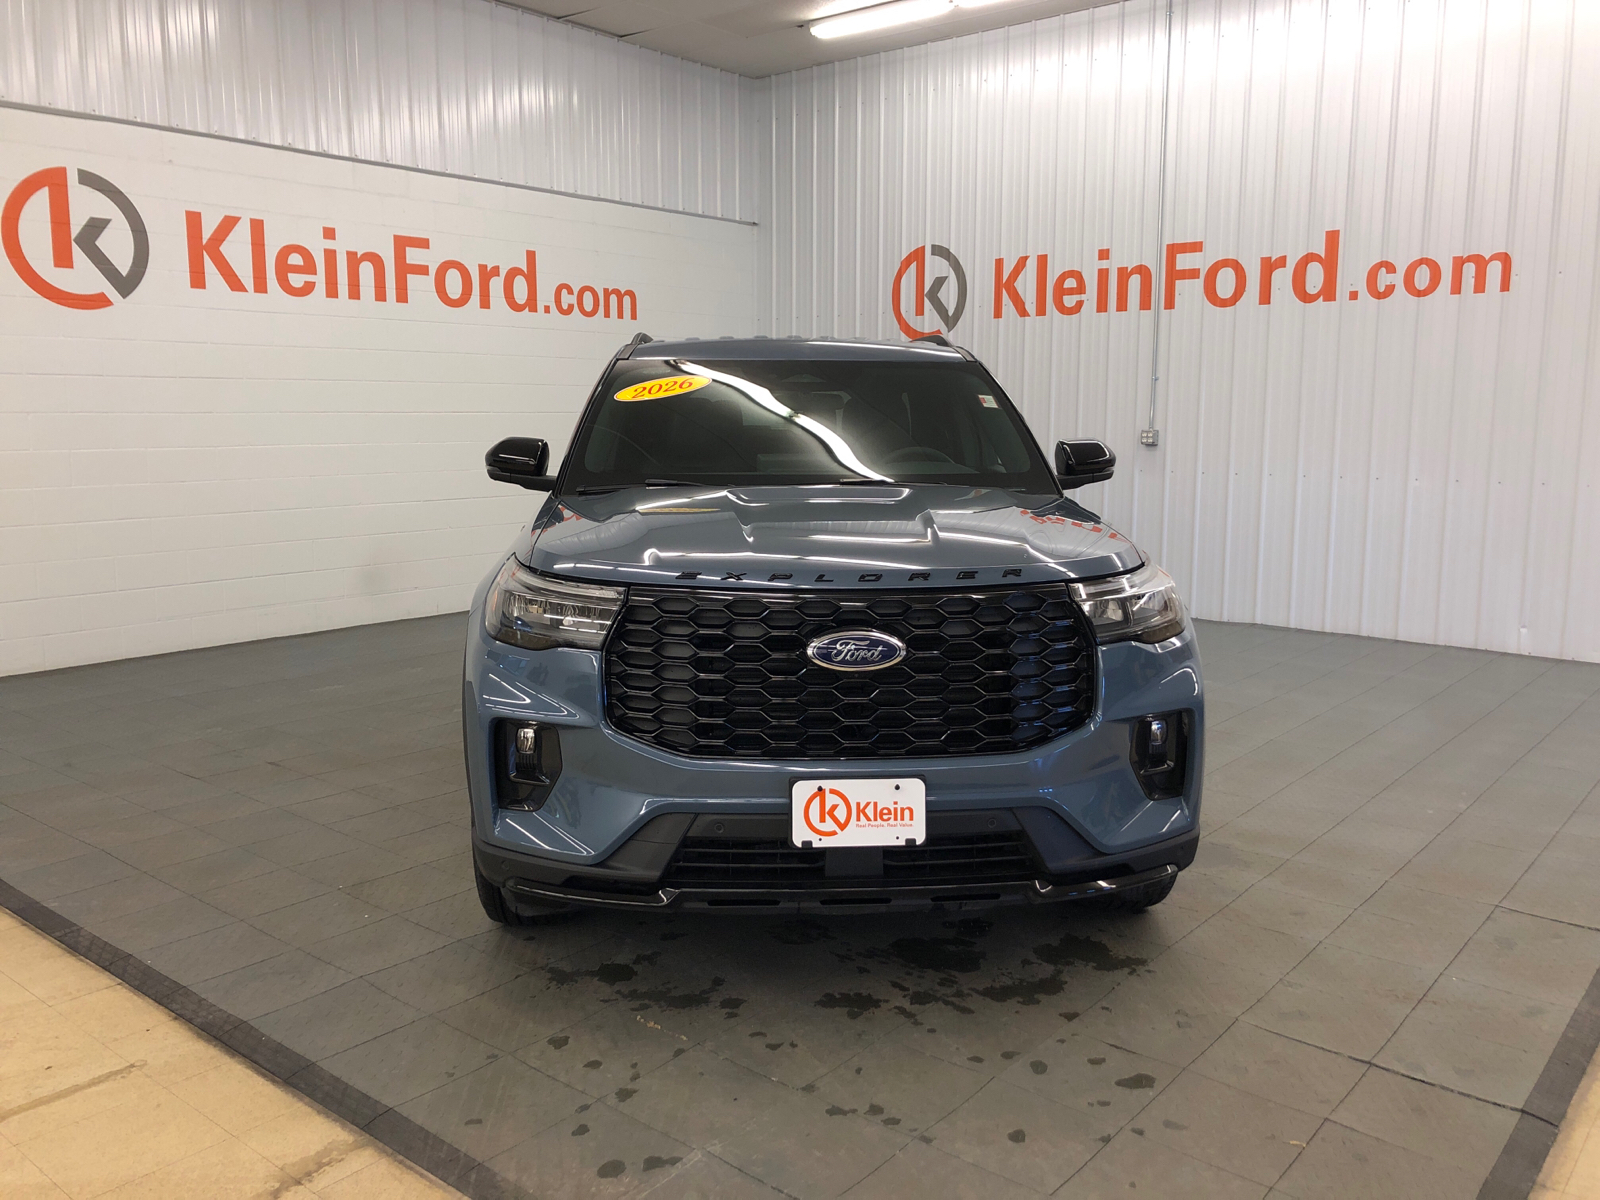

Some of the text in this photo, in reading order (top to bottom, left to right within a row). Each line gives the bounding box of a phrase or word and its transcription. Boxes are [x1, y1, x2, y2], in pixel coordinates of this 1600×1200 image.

[186, 211, 637, 320] KleinFord.com
[994, 230, 1511, 319] KleinFord.com
[632, 378, 695, 399] 2026
[675, 568, 1023, 583] EXPLORER
[831, 639, 884, 662] Ford
[856, 802, 913, 821] Klein
